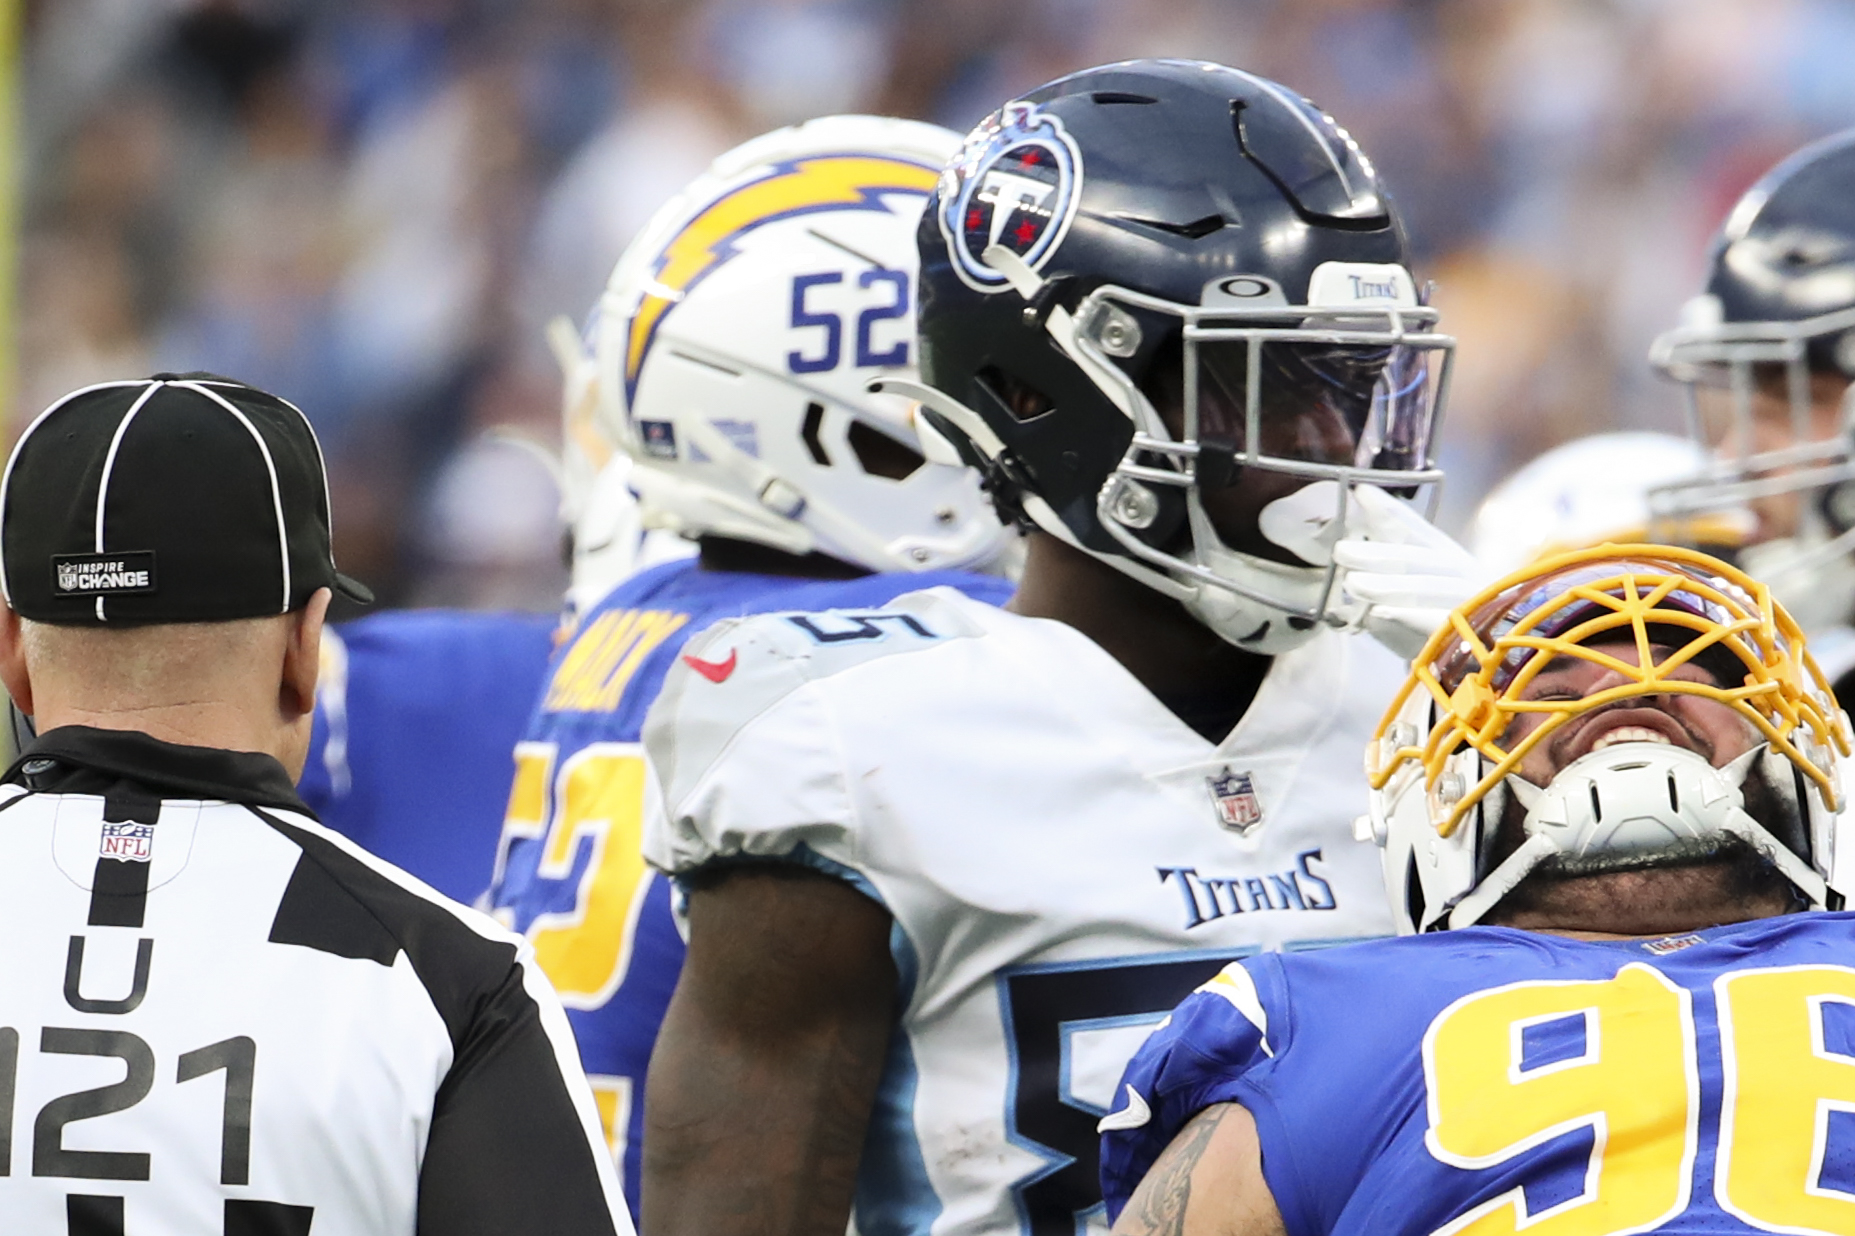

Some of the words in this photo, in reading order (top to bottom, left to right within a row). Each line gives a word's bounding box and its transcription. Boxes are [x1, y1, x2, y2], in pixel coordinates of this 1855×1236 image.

[787, 268, 911, 374] 52
[78, 561, 125, 574] INSPIRE
[78, 571, 149, 589] CHANGE
[104, 837, 148, 857] NFL
[1156, 848, 1338, 930] TITANS
[63, 935, 154, 1015] U
